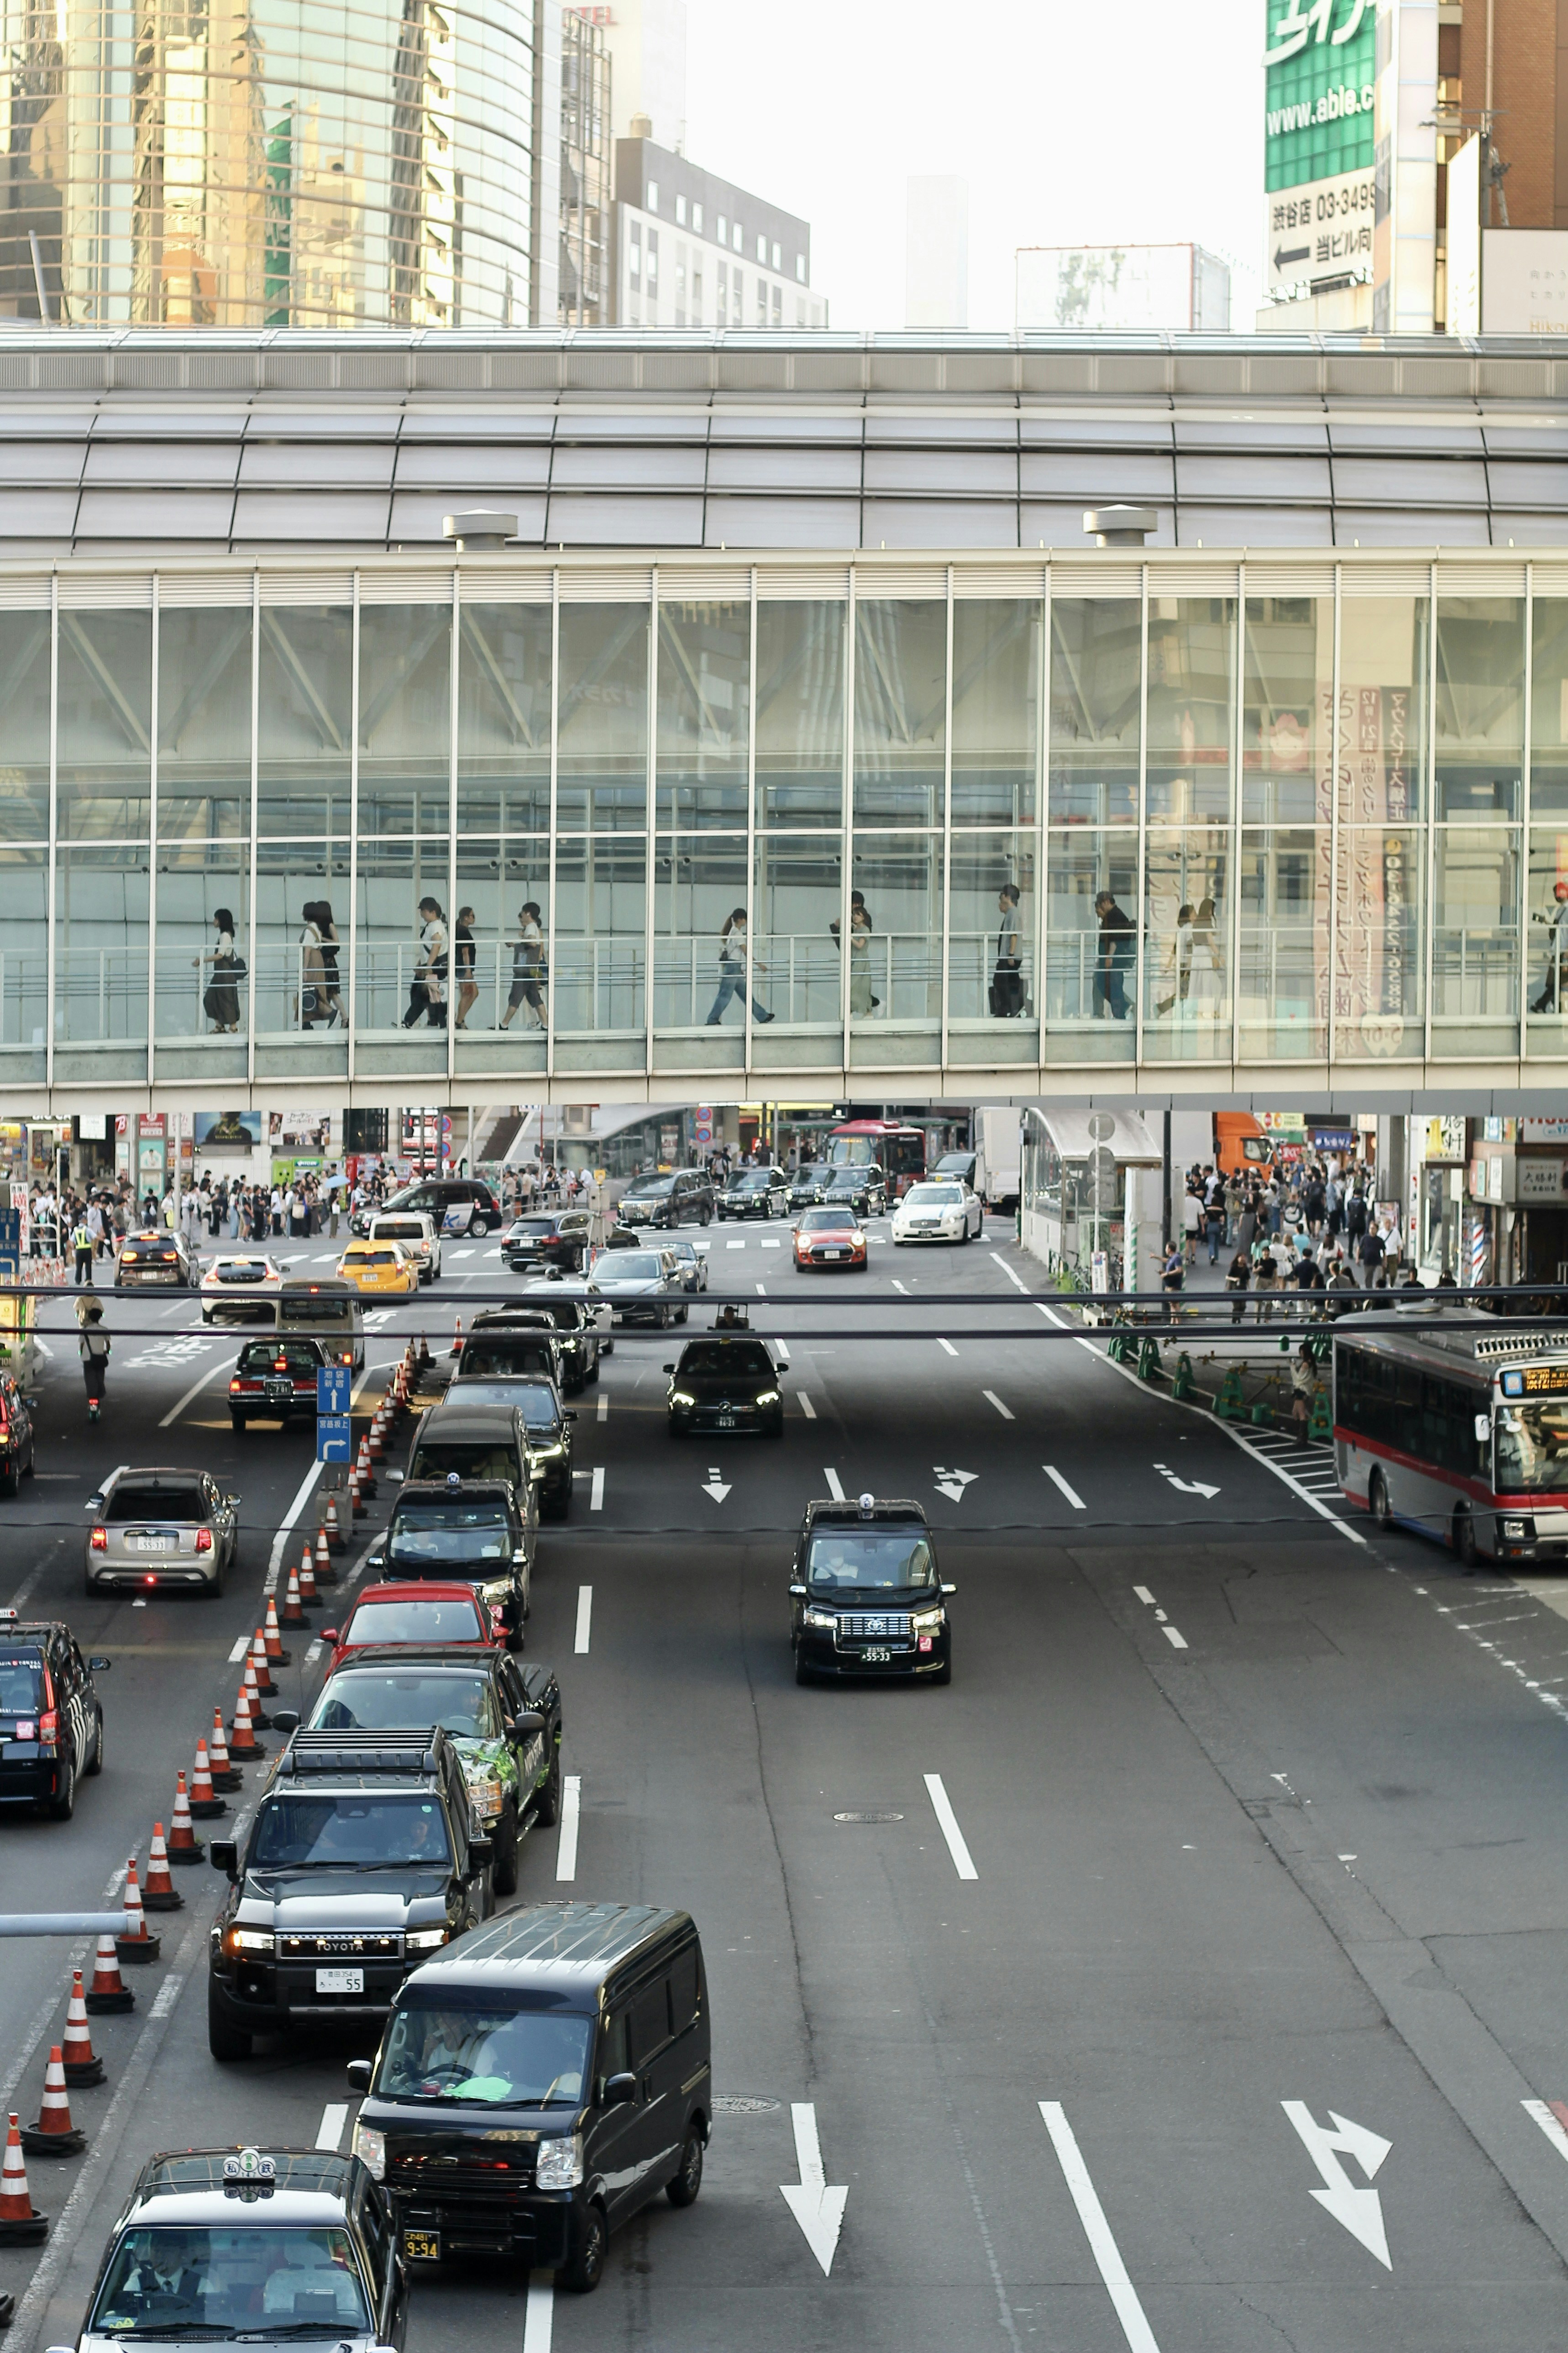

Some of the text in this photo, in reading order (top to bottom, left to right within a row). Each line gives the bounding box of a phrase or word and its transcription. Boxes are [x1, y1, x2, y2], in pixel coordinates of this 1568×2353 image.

[1273, 198, 1311, 232] 渋谷店
[325, 1371, 344, 1379] 池袋
[325, 1380, 344, 1388] 新宿
[866, 1652, 890, 1661] 55-33
